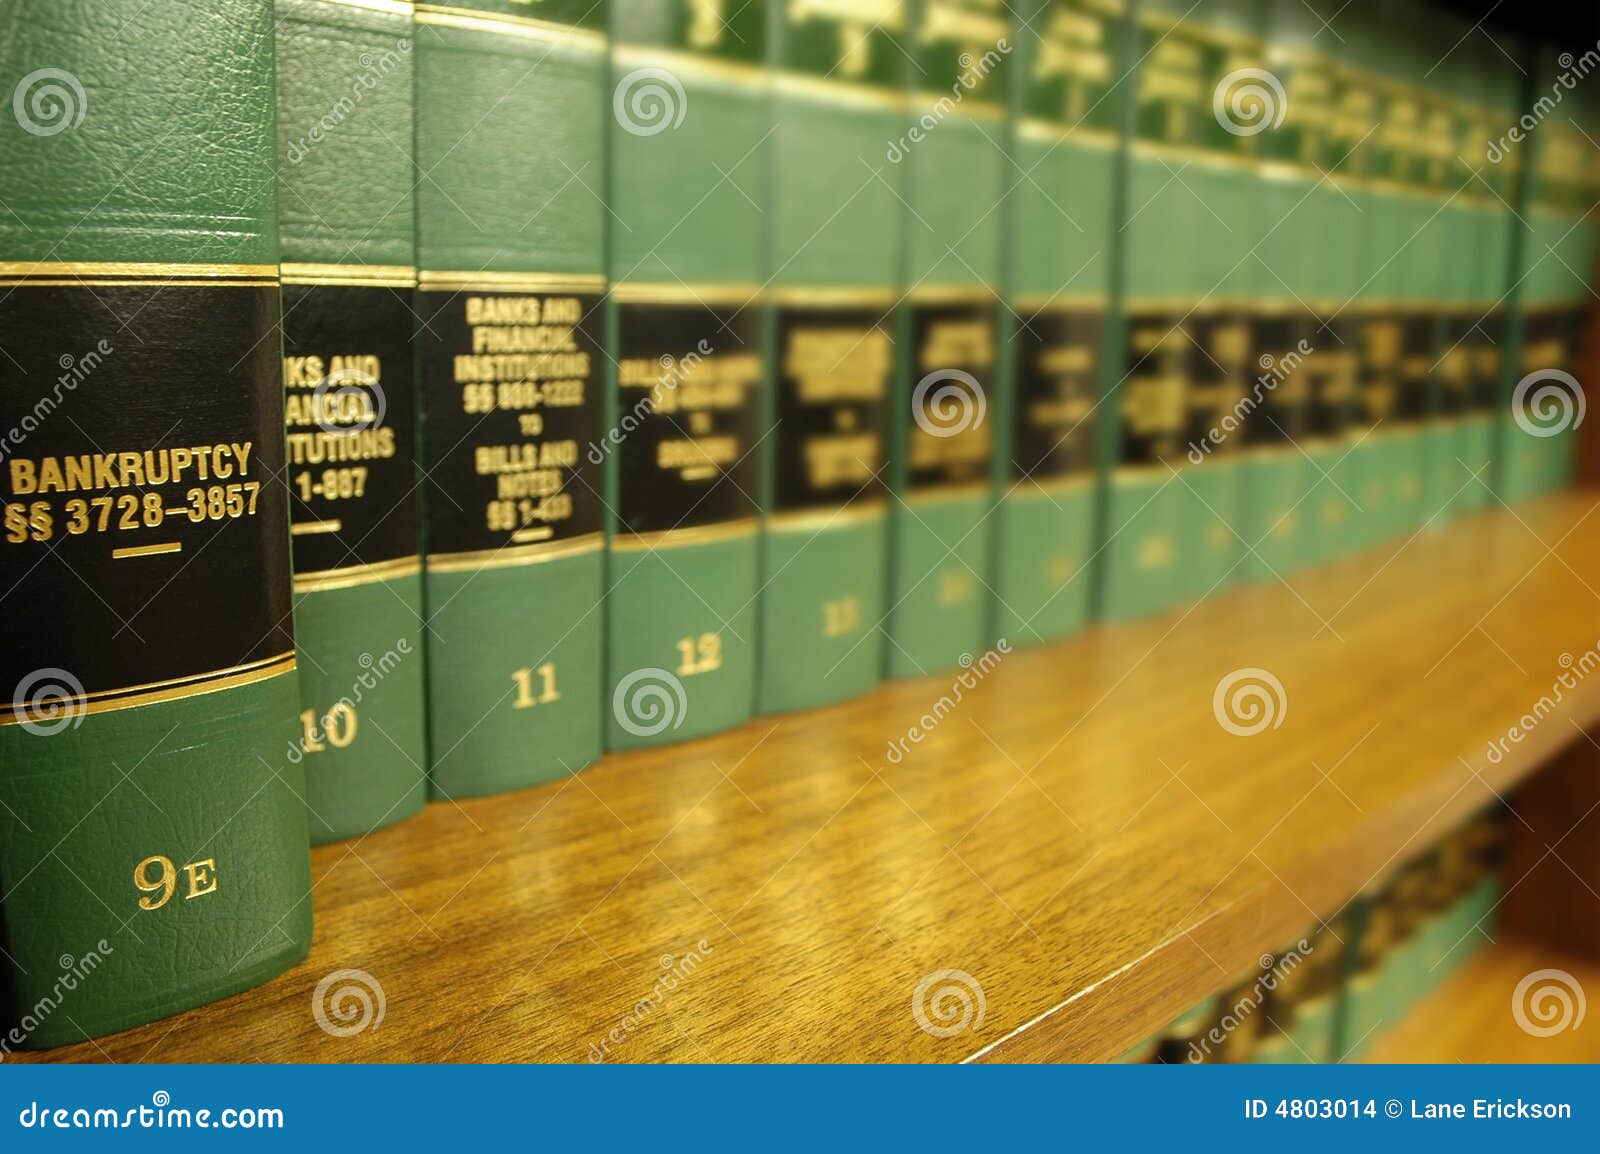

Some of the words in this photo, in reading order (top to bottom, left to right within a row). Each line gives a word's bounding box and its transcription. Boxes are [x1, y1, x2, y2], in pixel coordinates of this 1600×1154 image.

[466, 297, 541, 325] BANKS
[542, 297, 582, 325] AND
[328, 354, 381, 386] AND
[9, 442, 252, 494] BANKRUPTCY
[539, 440, 579, 467] AND
[676, 633, 723, 676] 12
[511, 663, 561, 709] 11
[300, 702, 358, 753] 10
[133, 855, 218, 911] 9E
